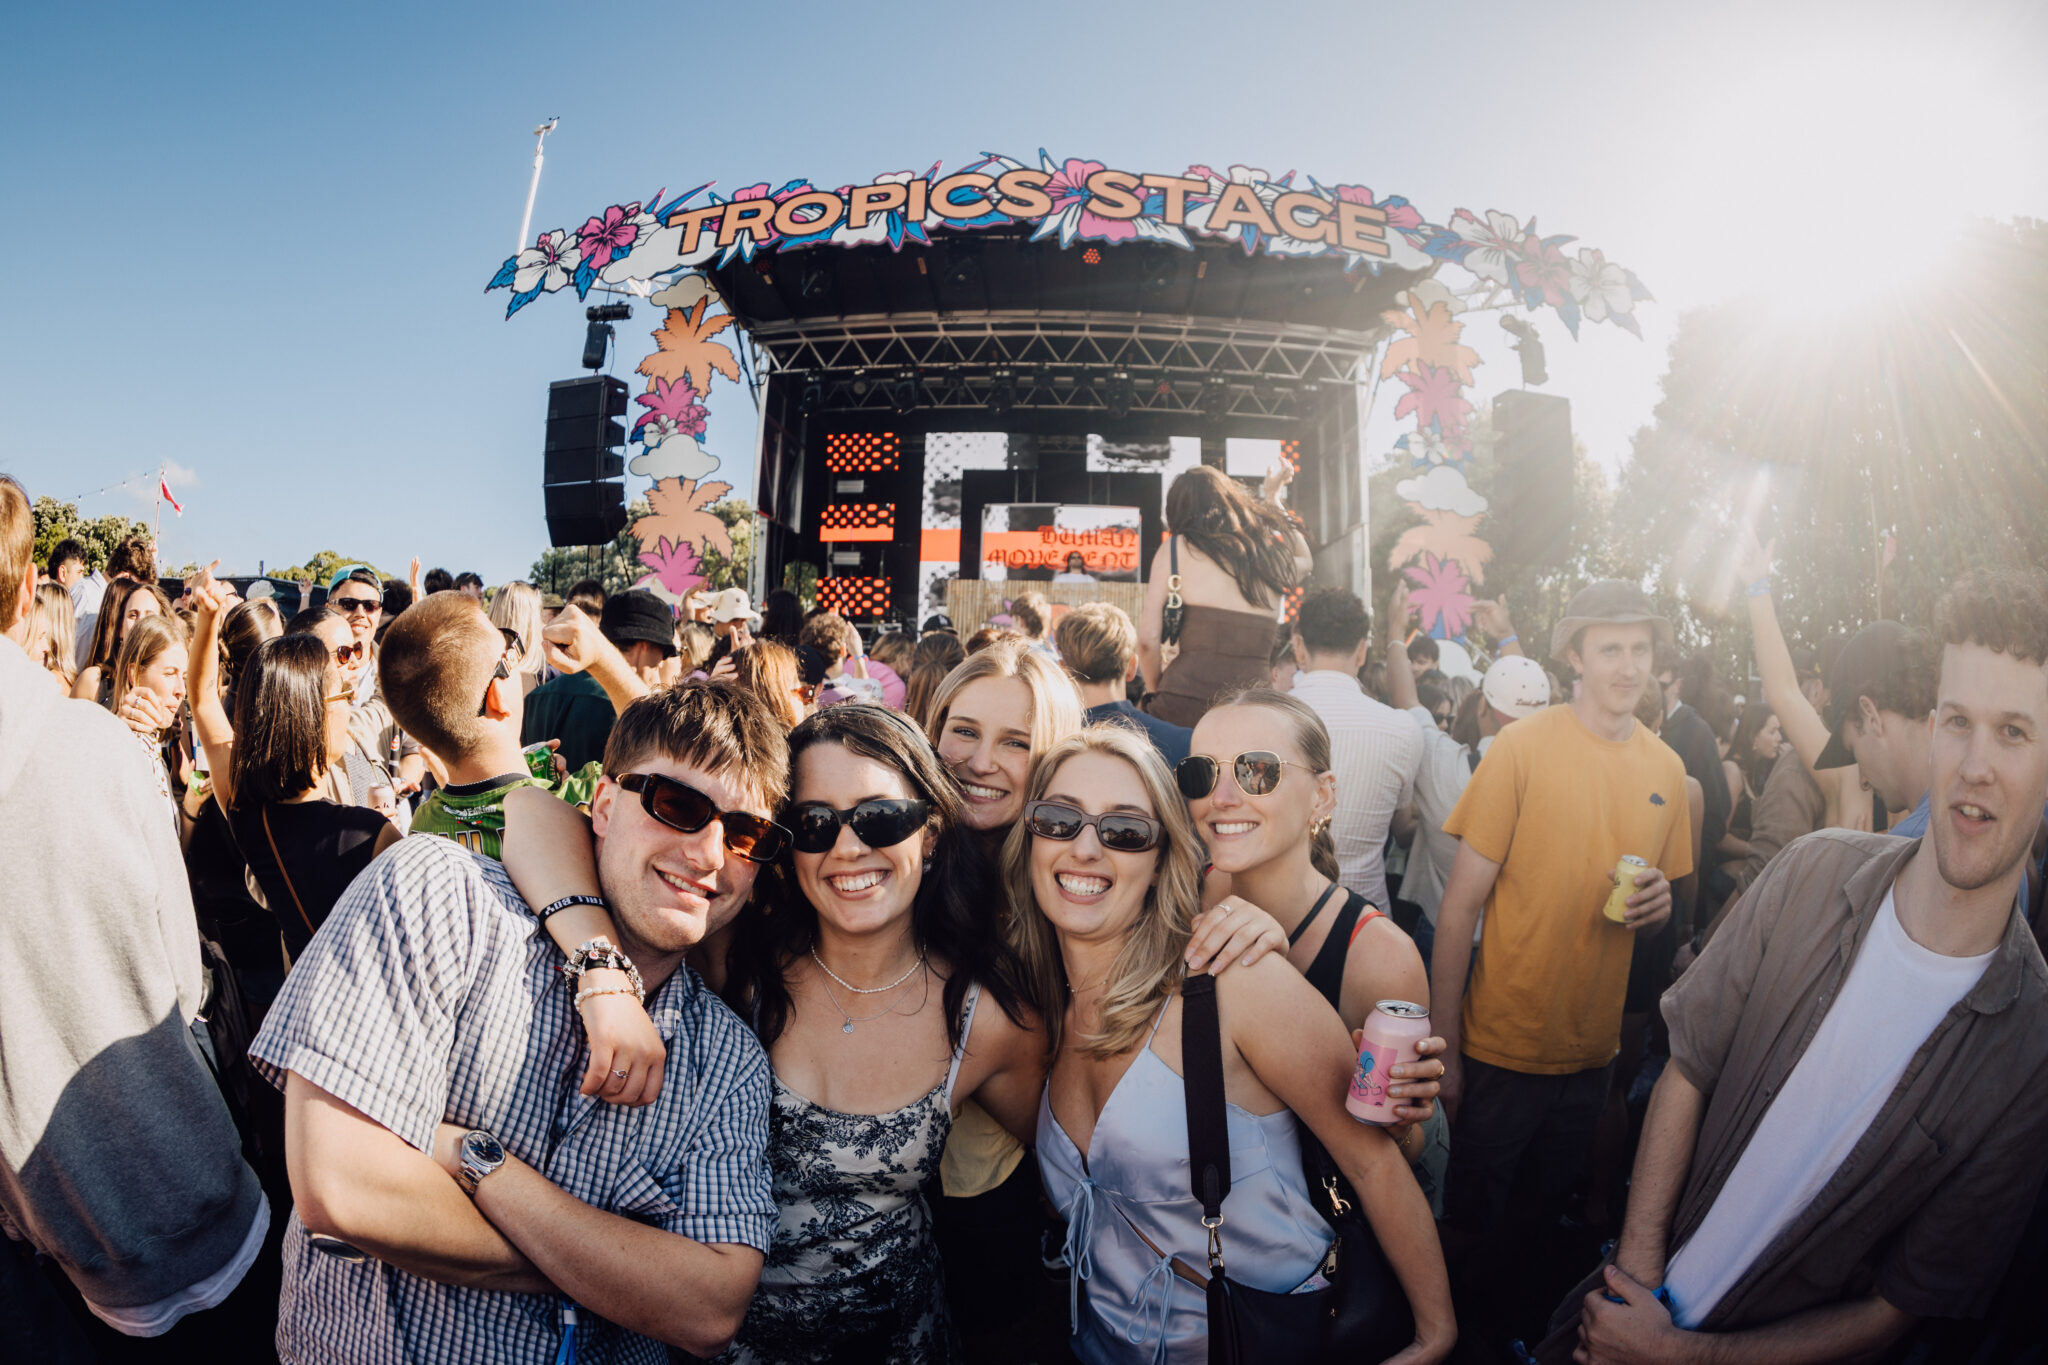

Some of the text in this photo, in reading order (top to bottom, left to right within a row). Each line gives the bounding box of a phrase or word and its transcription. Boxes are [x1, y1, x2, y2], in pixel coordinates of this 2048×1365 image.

[666, 168, 1391, 259] TROPICS STAGE
[985, 548, 1136, 572] MOVEENT
[545, 895, 604, 916] TALL BOY
